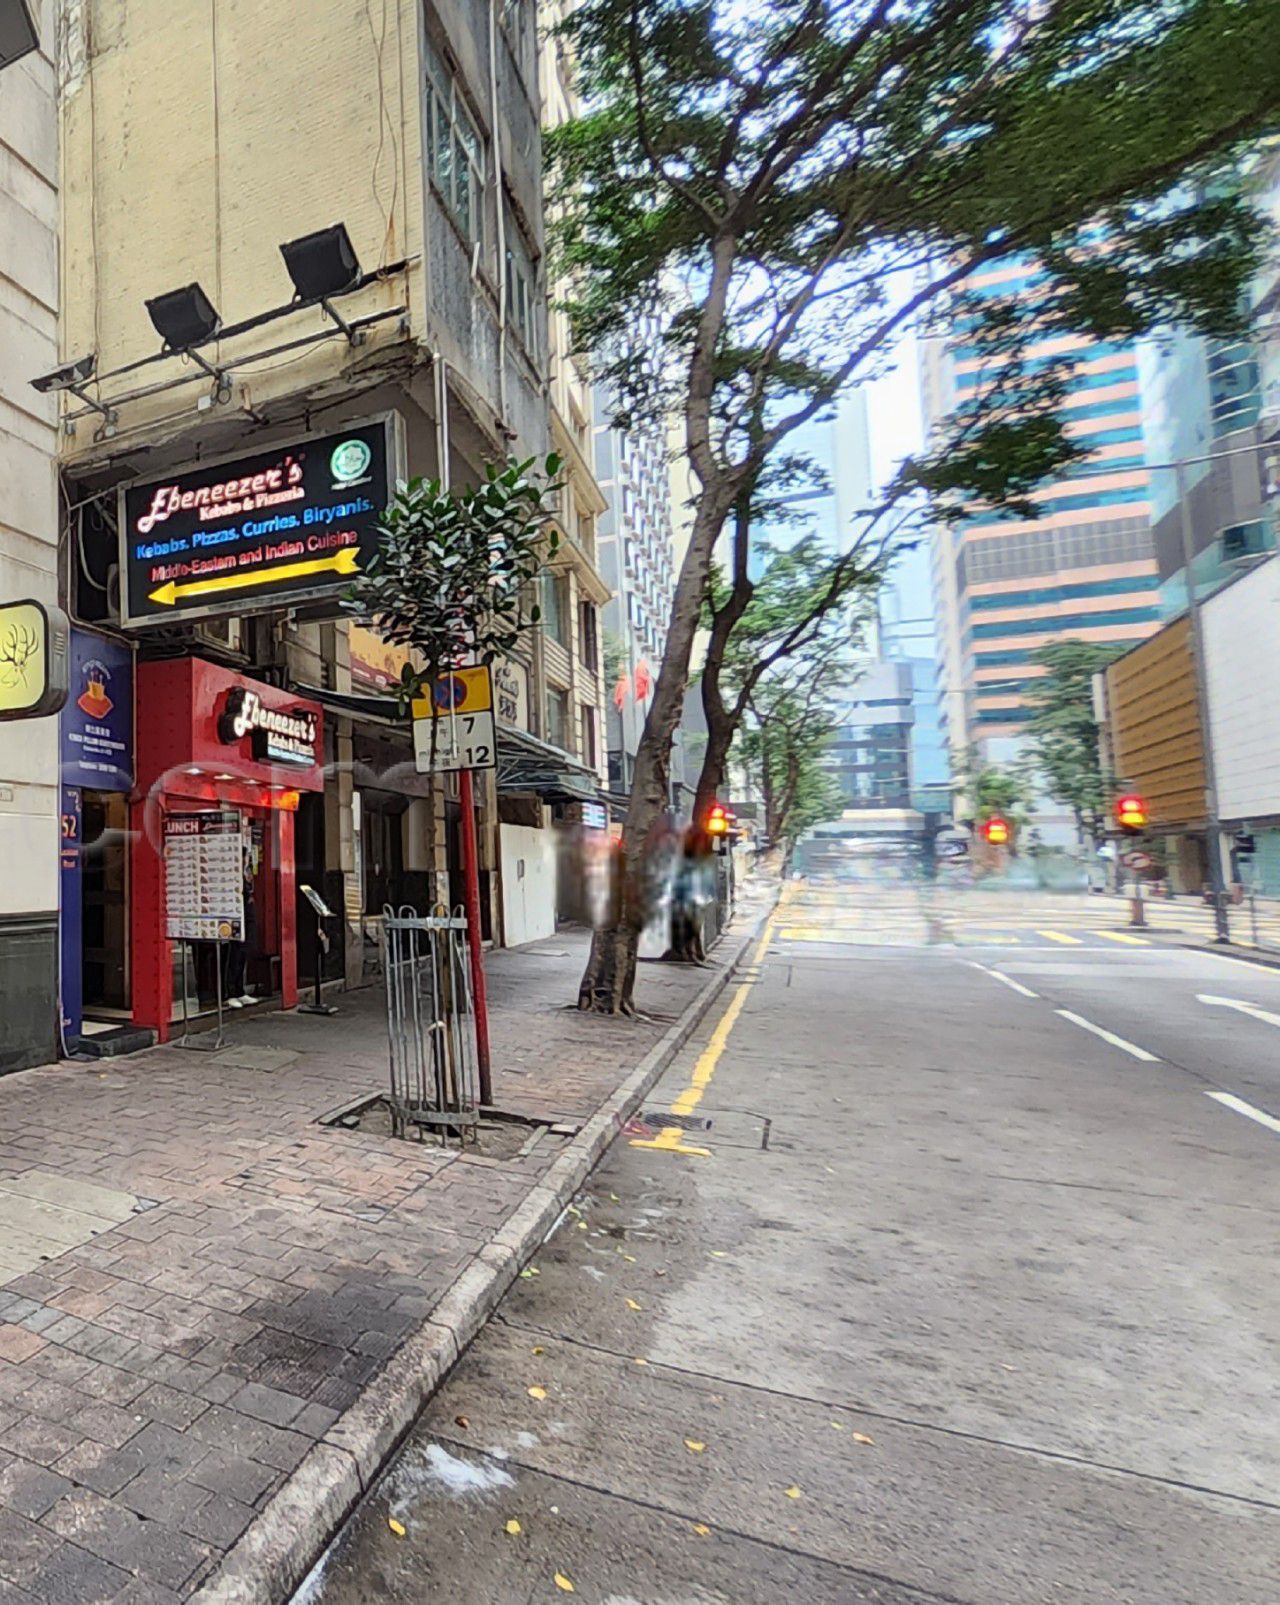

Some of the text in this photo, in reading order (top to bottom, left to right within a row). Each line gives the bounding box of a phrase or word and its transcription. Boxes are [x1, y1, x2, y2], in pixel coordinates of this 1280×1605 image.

[137, 455, 303, 534] Ebeneezer's
[238, 547, 264, 566] and
[265, 540, 305, 561] Indian
[306, 529, 359, 552] Cuisine
[462, 716, 475, 735] 7
[465, 745, 490, 765] 12
[165, 821, 200, 834] UNCH
